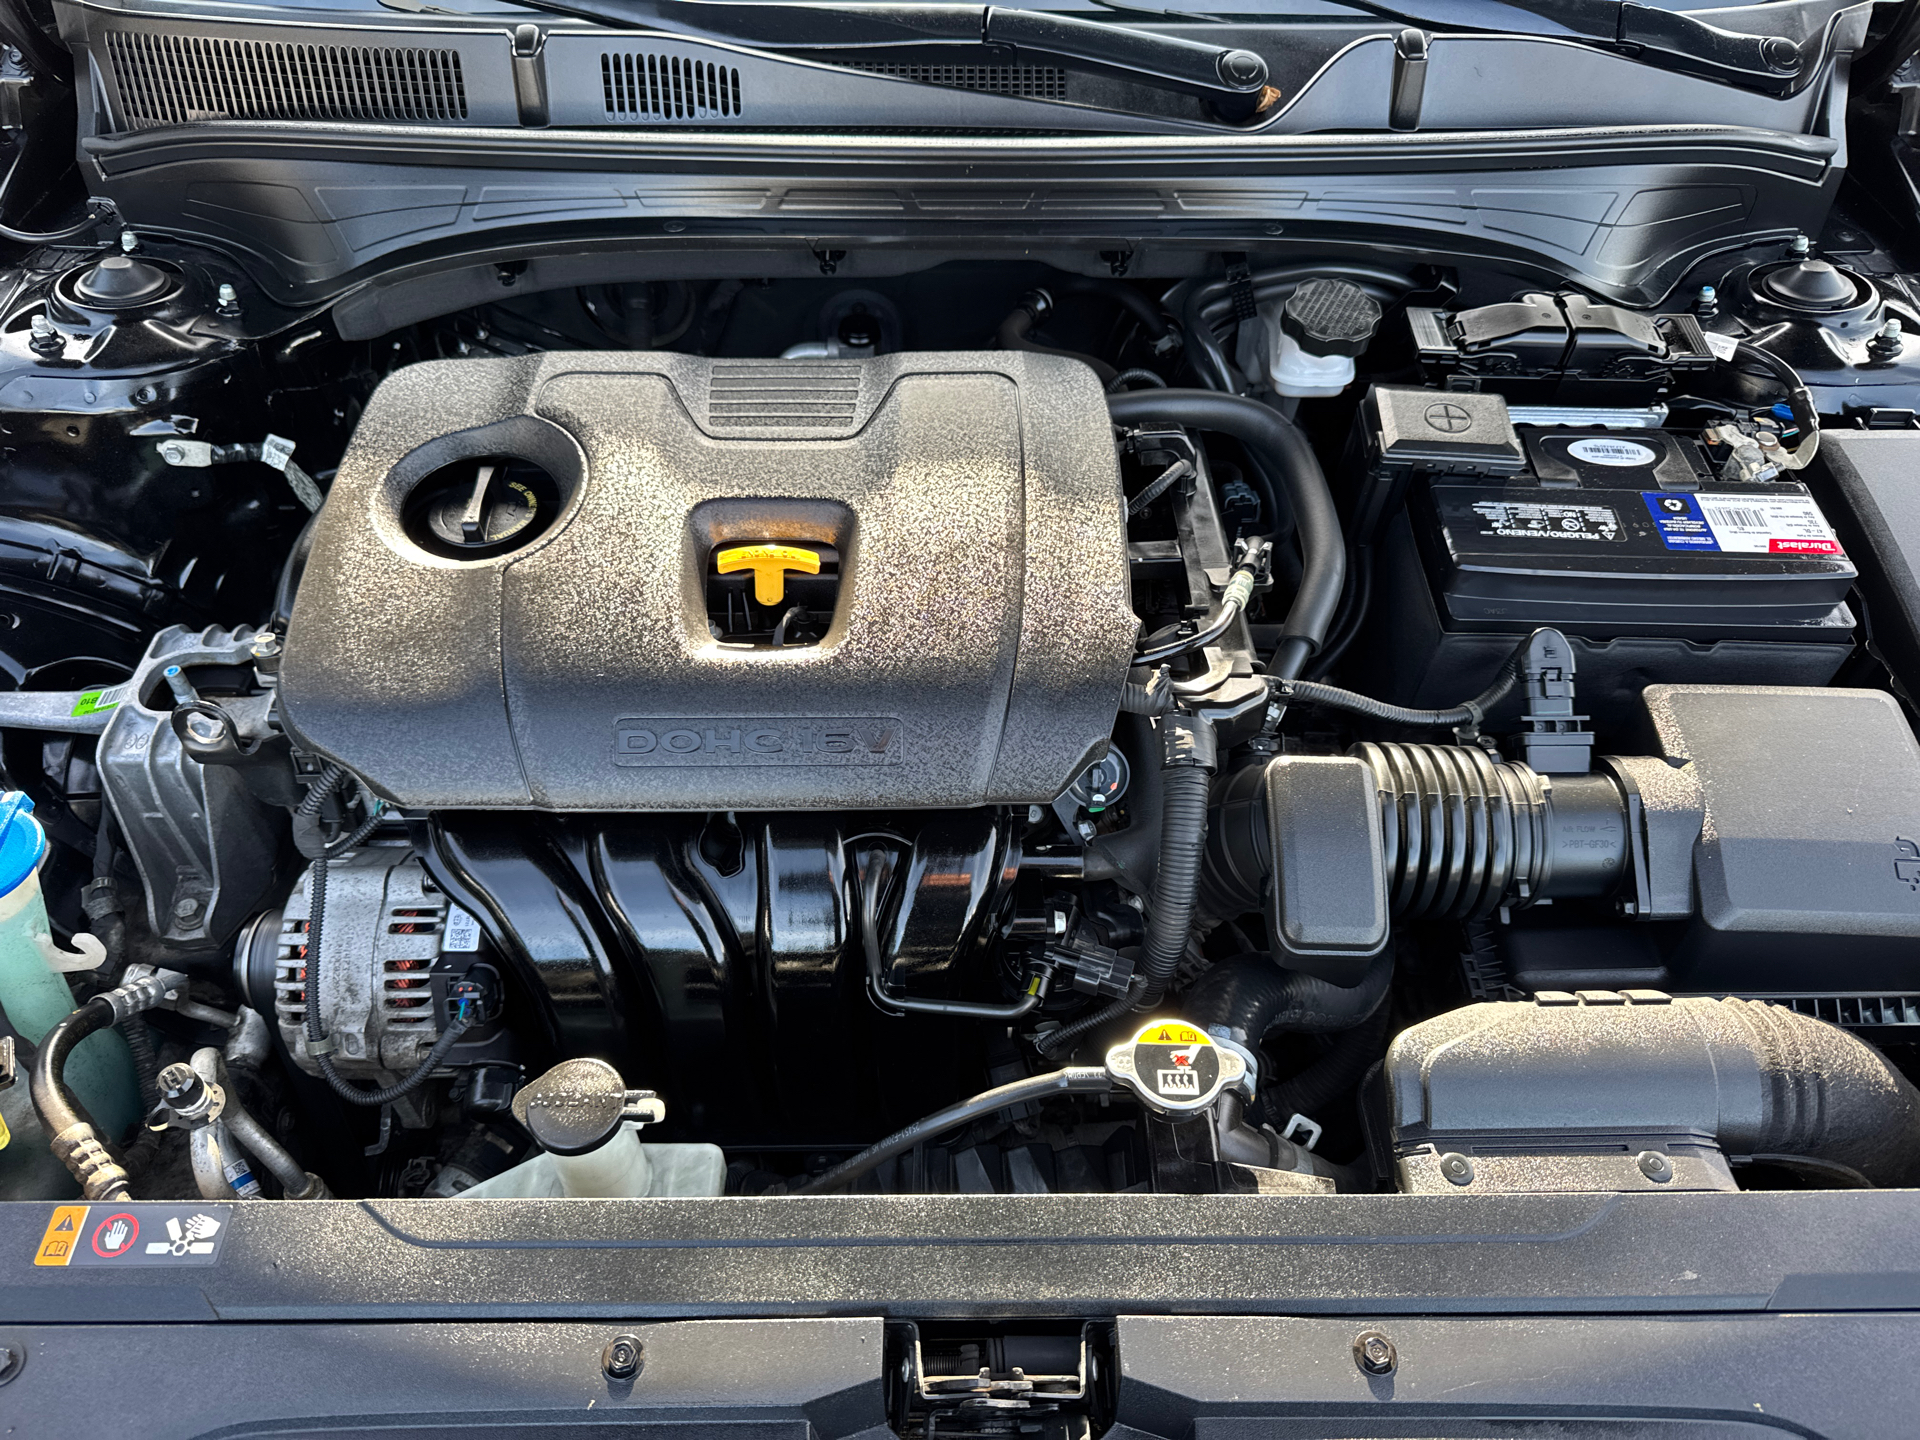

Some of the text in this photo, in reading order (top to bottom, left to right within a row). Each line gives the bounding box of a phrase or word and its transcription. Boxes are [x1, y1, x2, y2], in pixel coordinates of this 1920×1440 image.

[508, 481, 526, 492] SEE
[490, 520, 529, 540] MANUAL
[1496, 528, 1600, 540] PELIGRO/VENENO
[1776, 542, 1836, 551] Duralast
[618, 728, 896, 754] DOHC 16V
